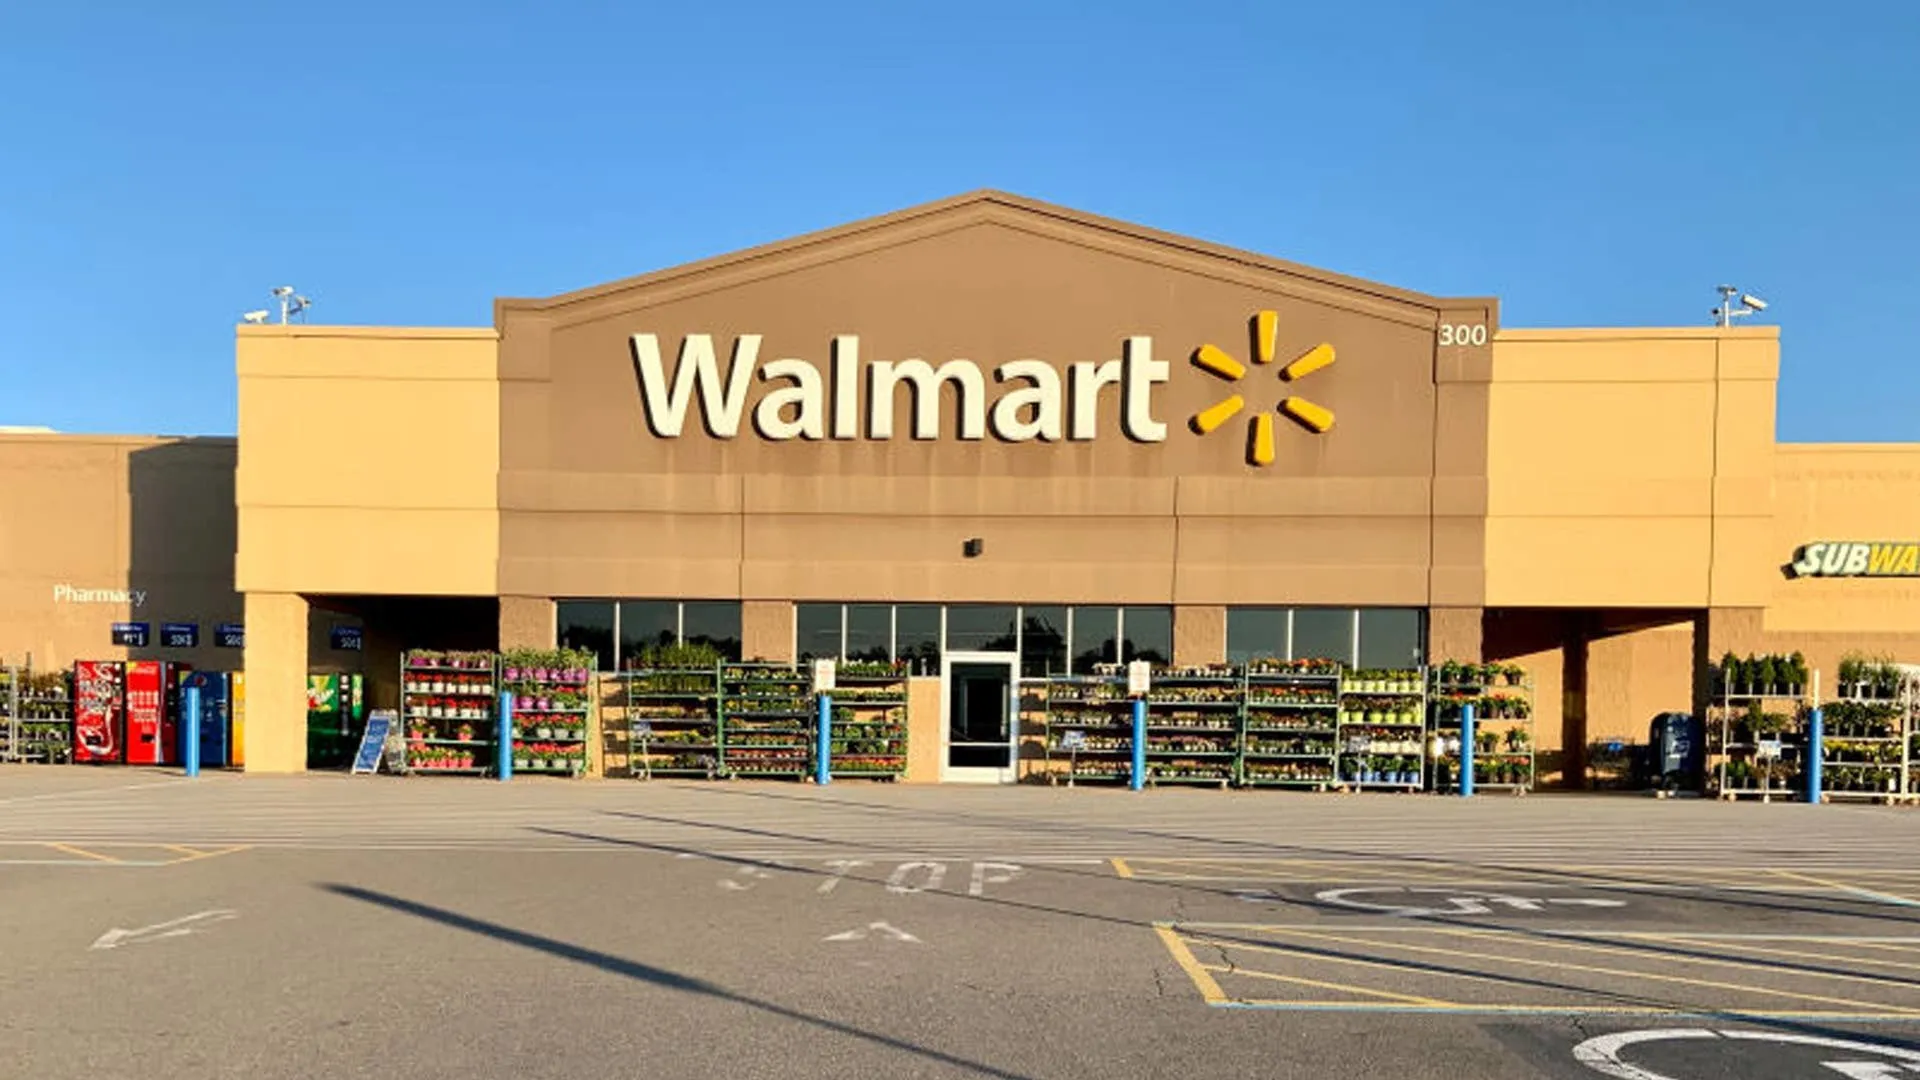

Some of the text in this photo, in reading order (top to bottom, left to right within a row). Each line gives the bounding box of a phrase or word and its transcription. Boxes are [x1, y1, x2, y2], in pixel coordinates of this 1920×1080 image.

[1439, 323, 1487, 346] 300
[630, 333, 1170, 442] Walmart
[1793, 542, 1919, 575] SUBWA
[53, 583, 146, 607] Pharmacy
